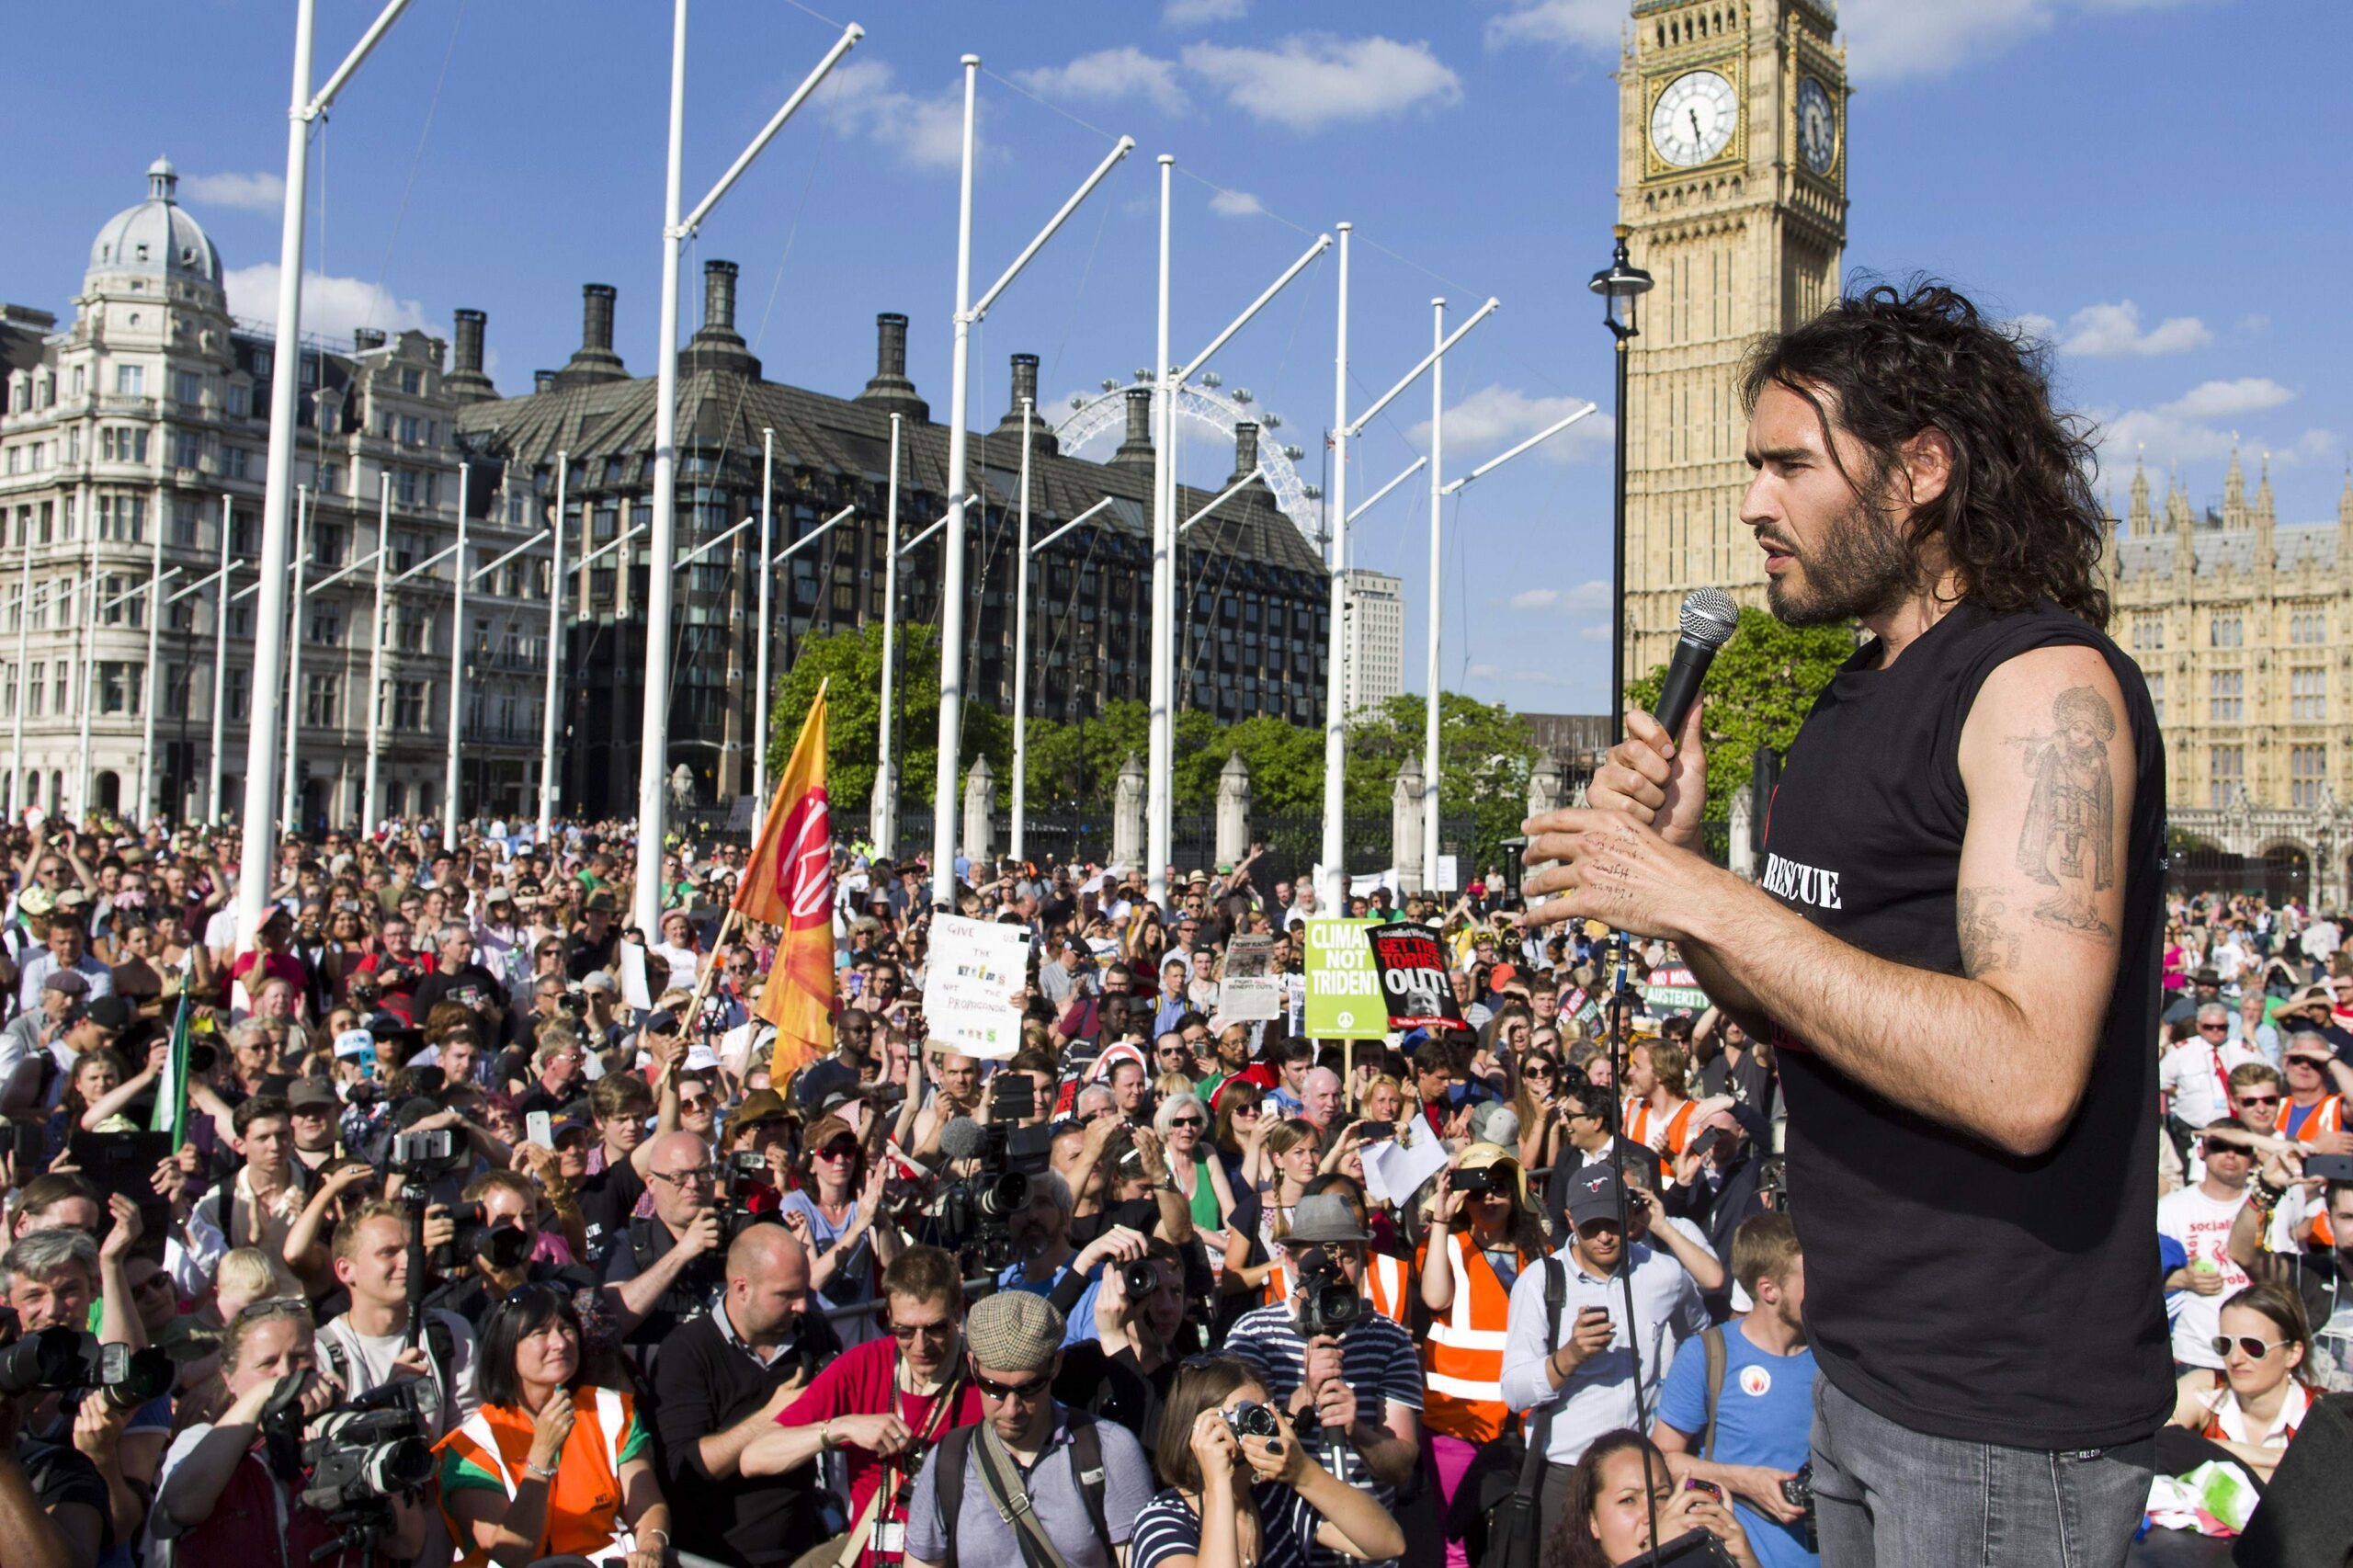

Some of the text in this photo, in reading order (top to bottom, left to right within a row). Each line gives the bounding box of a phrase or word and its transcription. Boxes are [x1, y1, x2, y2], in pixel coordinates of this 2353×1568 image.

[1762, 852, 1842, 909] RESCUE
[947, 923, 1017, 943] GIVE US
[1312, 924, 1377, 949] CLIMAT
[974, 948, 992, 957] THE
[1378, 937, 1439, 957] GET THE
[1325, 949, 1367, 969] NOT
[1381, 952, 1444, 971] TORIES
[1312, 970, 1379, 995] TRIDENT
[1385, 968, 1450, 997] OUT!
[1651, 971, 1667, 985] NO
